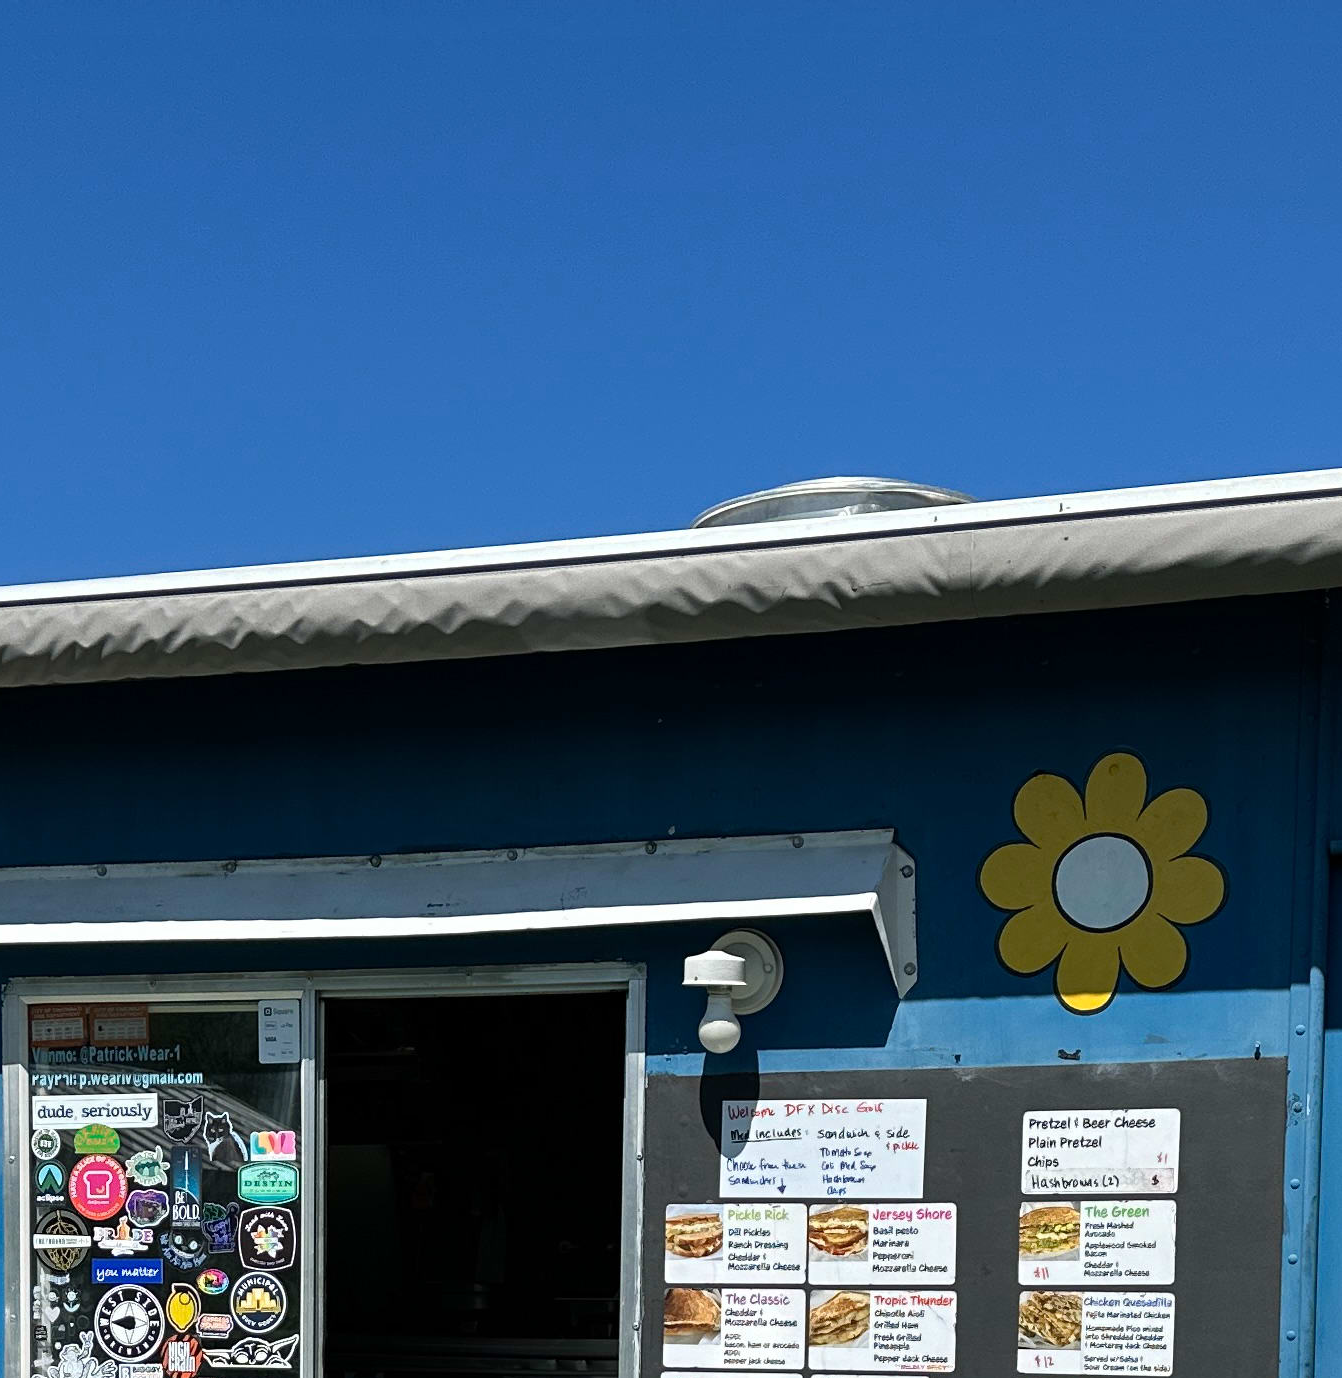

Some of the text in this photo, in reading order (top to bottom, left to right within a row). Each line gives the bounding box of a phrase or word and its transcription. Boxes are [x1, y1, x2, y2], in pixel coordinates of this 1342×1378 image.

[80, 1044, 181, 1064] @Patrick-Wear-1
[81, 1103, 153, 1121] seriously
[728, 1105, 775, 1120] Welcome
[821, 1102, 849, 1114] Disc
[1028, 1116, 1156, 1130] Pretzel Beer Cheese
[885, 1127, 910, 1138] side
[1028, 1136, 1102, 1149] Plain Pretzel
[726, 1157, 779, 1171] Choose from
[1028, 1156, 1059, 1170] Chips
[1102, 1175, 1120, 1188] (2)
[174, 1190, 186, 1205] BE
[727, 1208, 790, 1221] Pickle Rick
[872, 1208, 953, 1223] Jersey Shore
[1084, 1205, 1150, 1218] The Green
[728, 1227, 771, 1237] Dill Pickles
[873, 1226, 894, 1236] Basil
[1084, 1222, 1105, 1230] Fresh
[728, 1240, 789, 1251] Ranch Dressing
[872, 1239, 910, 1248] Marinara
[728, 1253, 761, 1262] Cheddar
[872, 1251, 915, 1262] Pepperoni
[727, 1262, 801, 1272] Mozzarella Cheese
[872, 1264, 948, 1273] Mozzarella Cheese
[96, 1265, 160, 1282] you matter
[238, 1277, 279, 1297] MUNICIPAL
[725, 1293, 790, 1306] The Classic
[873, 1295, 955, 1307] Tropic Thunder
[1084, 1297, 1173, 1307] Chicken Quesadilla
[100, 1290, 125, 1327] WEST
[134, 1291, 160, 1327] SIDE
[725, 1308, 758, 1317] Cheddar
[724, 1318, 798, 1327] Mozzarella Cheese
[874, 1321, 900, 1329] Grilled
[874, 1333, 922, 1342] Fresh Grilled
[874, 1355, 948, 1364] Pepper Cheese
